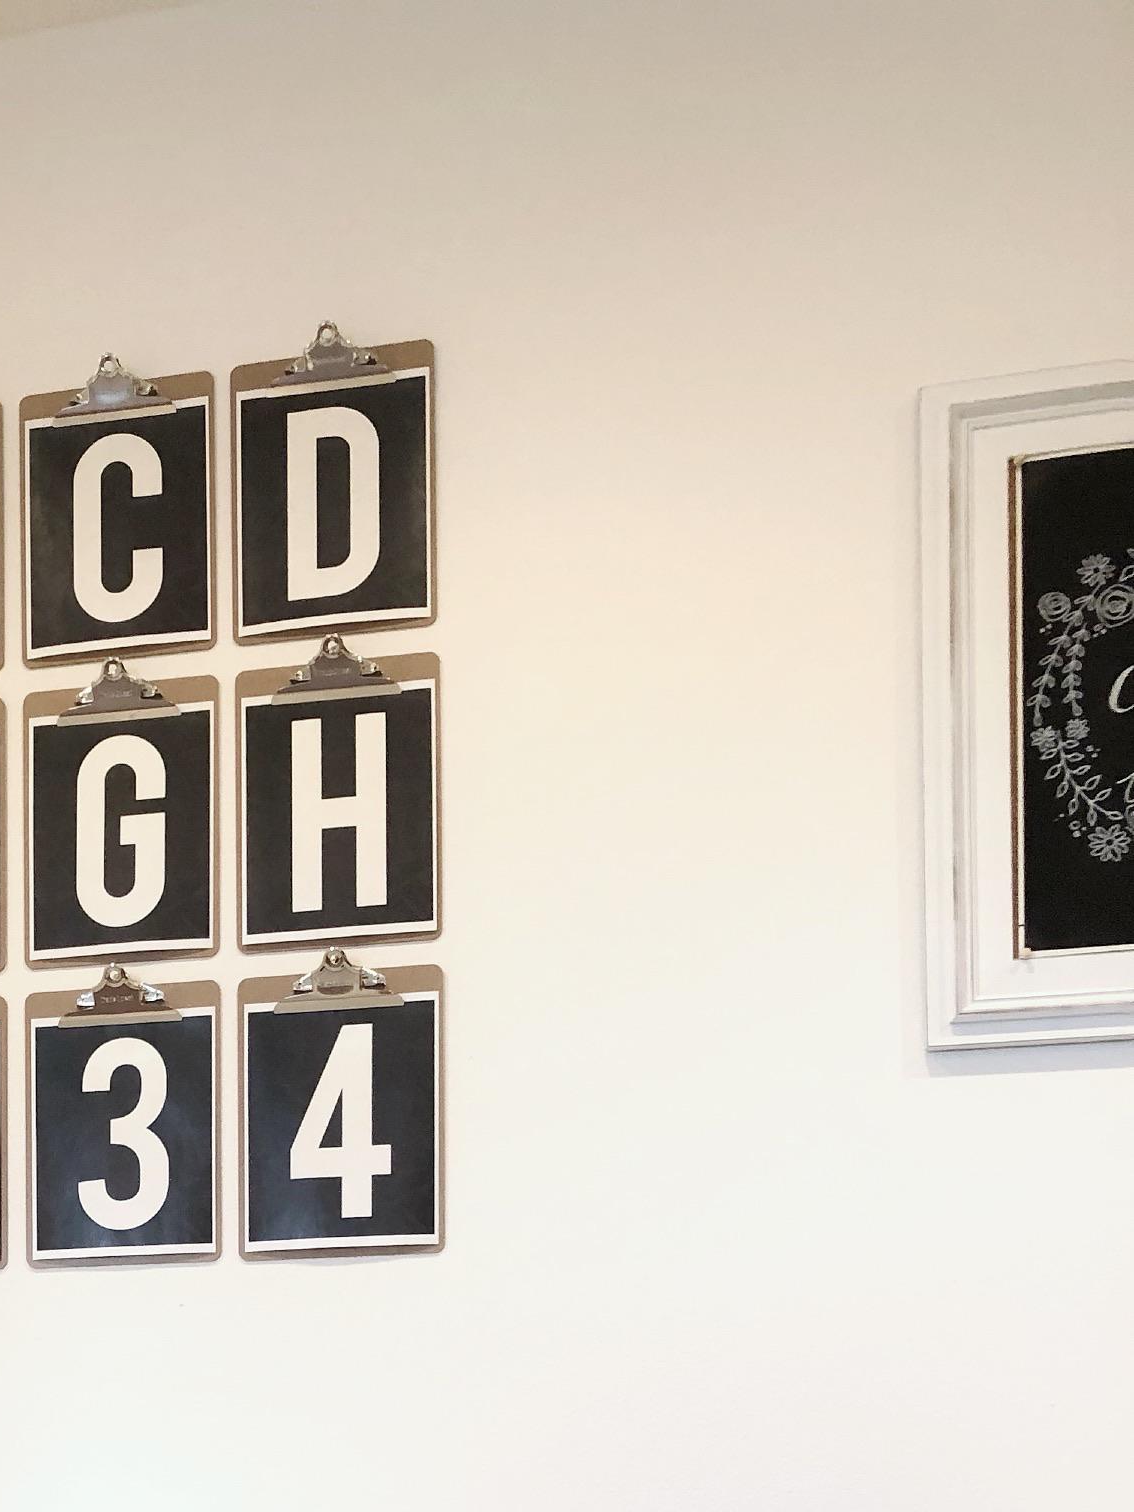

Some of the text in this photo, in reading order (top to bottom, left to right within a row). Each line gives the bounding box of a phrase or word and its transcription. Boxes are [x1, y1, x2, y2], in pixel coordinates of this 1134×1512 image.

[74, 434, 163, 622] C
[287, 407, 379, 601] D
[76, 735, 166, 927] G
[292, 712, 387, 912] H
[78, 1038, 169, 1230] 3
[290, 1024, 391, 1218] 4
